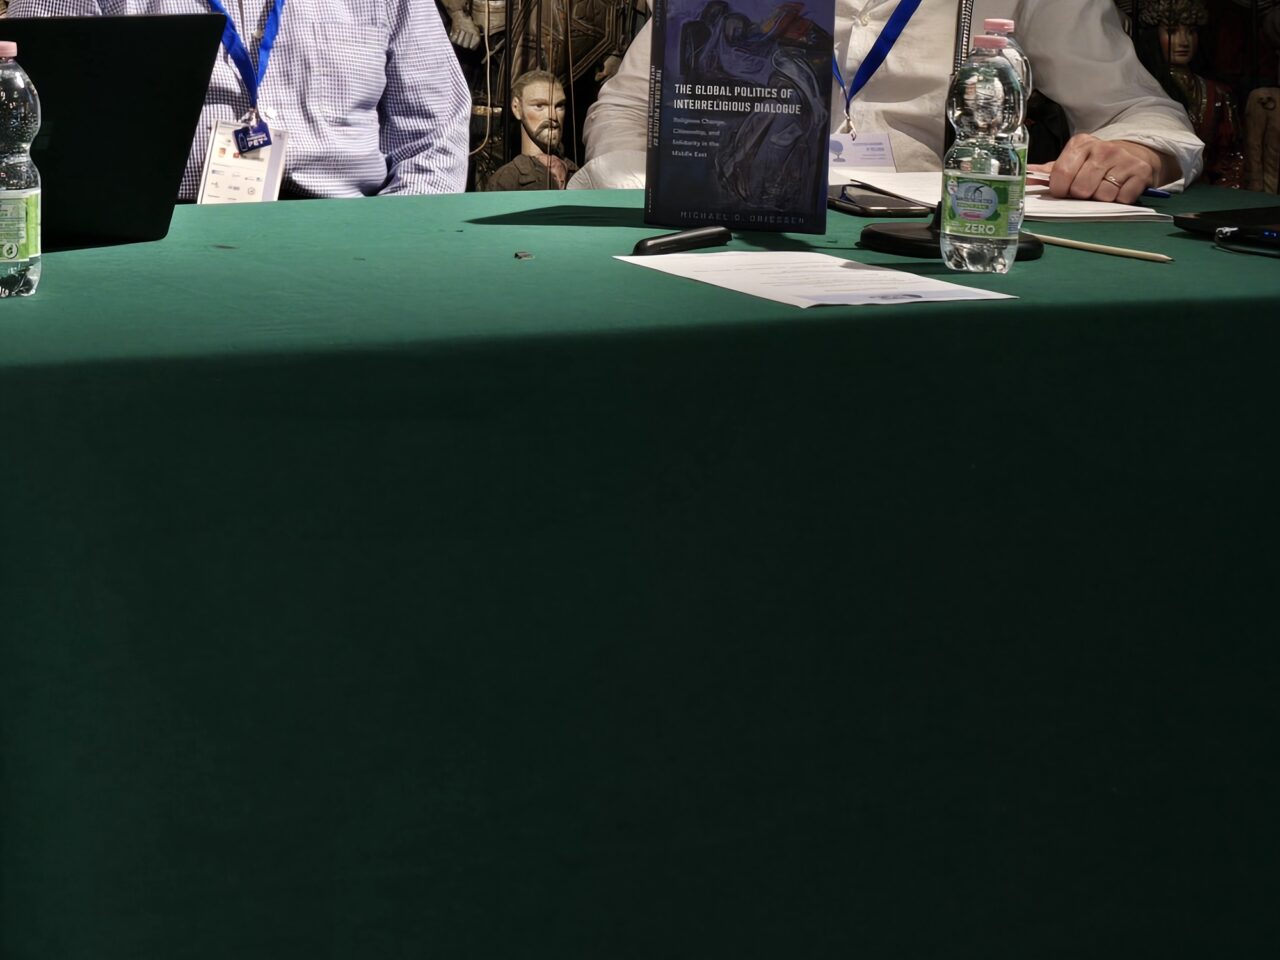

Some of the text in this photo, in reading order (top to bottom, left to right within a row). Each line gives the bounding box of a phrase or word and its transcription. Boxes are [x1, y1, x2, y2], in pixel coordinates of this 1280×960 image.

[674, 83, 793, 99] THE GLOBAL POLITICS OF
[673, 99, 802, 115] INTERRELIGIOUS DIALOGUE
[680, 210, 728, 222] MICHAEL
[965, 224, 995, 234] ZERO
